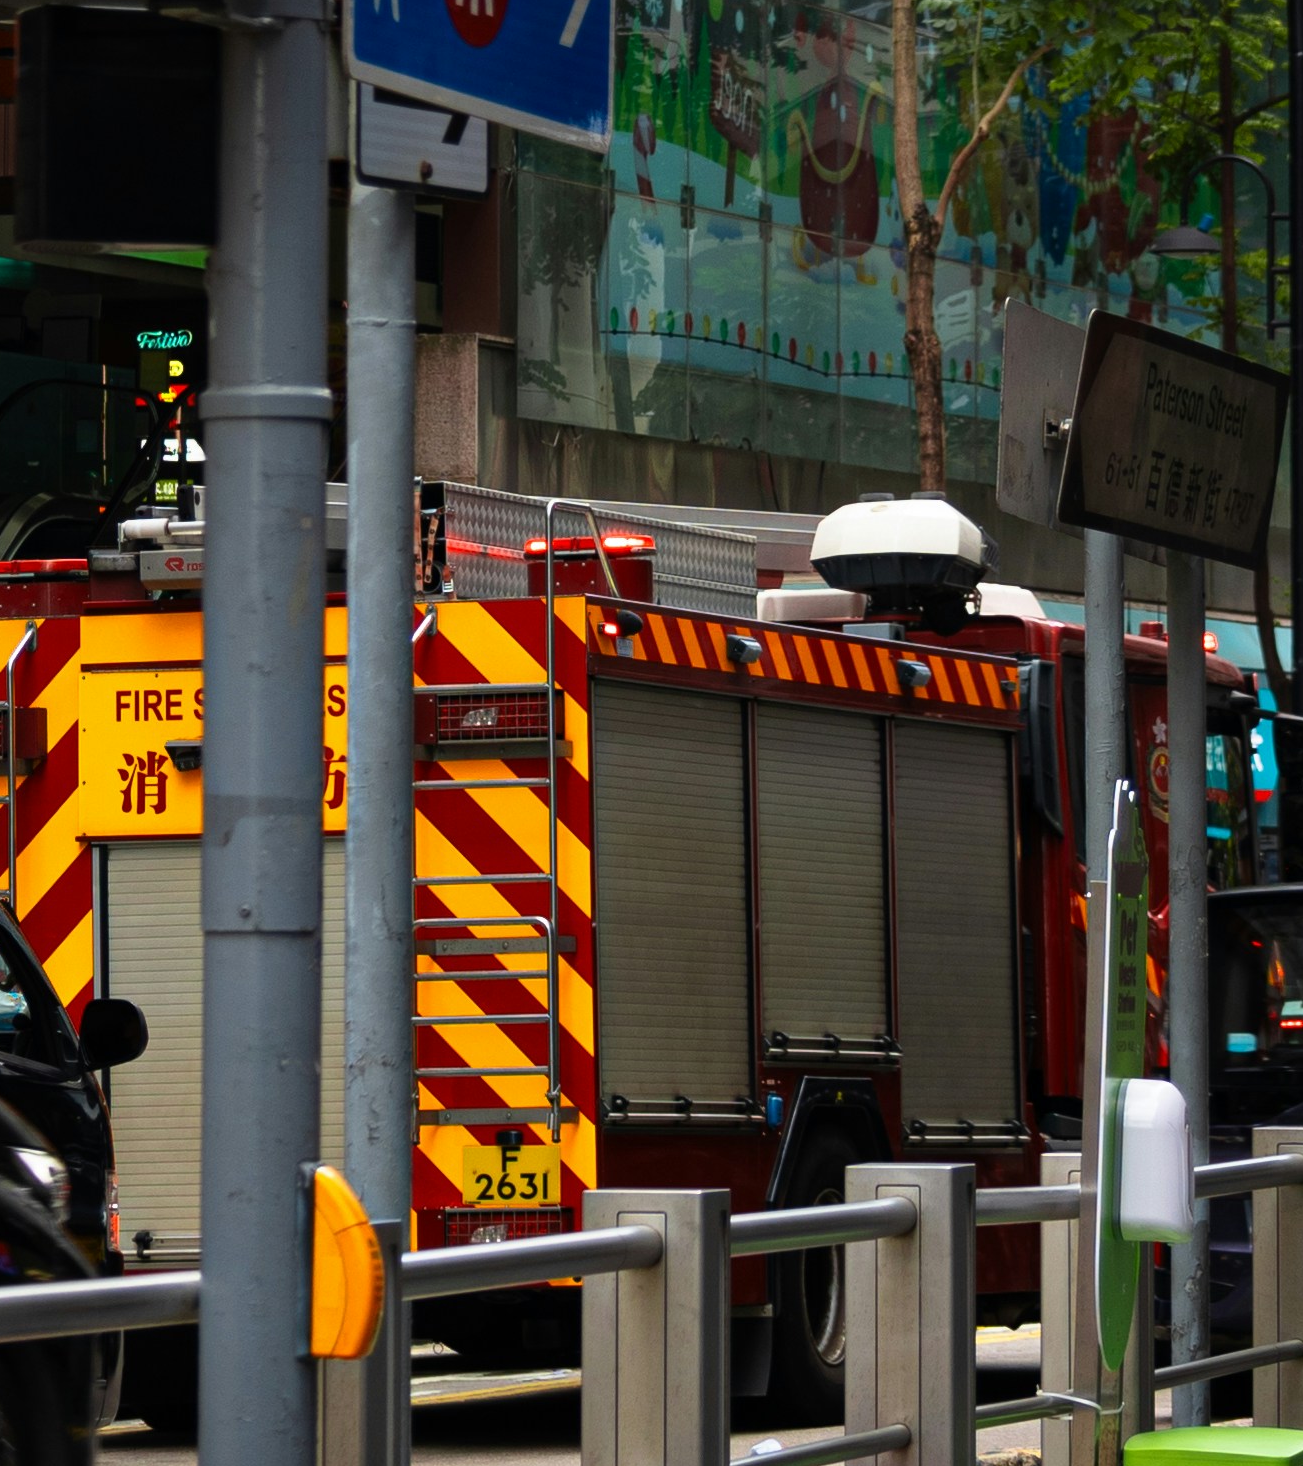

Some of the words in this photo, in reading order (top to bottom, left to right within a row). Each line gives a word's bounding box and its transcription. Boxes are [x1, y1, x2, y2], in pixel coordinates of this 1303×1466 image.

[1143, 362, 1204, 429] Paterson
[1206, 385, 1249, 439] Street
[116, 689, 183, 722] FIRE
[501, 1146, 521, 1173] F
[475, 1173, 548, 1200] 2631
